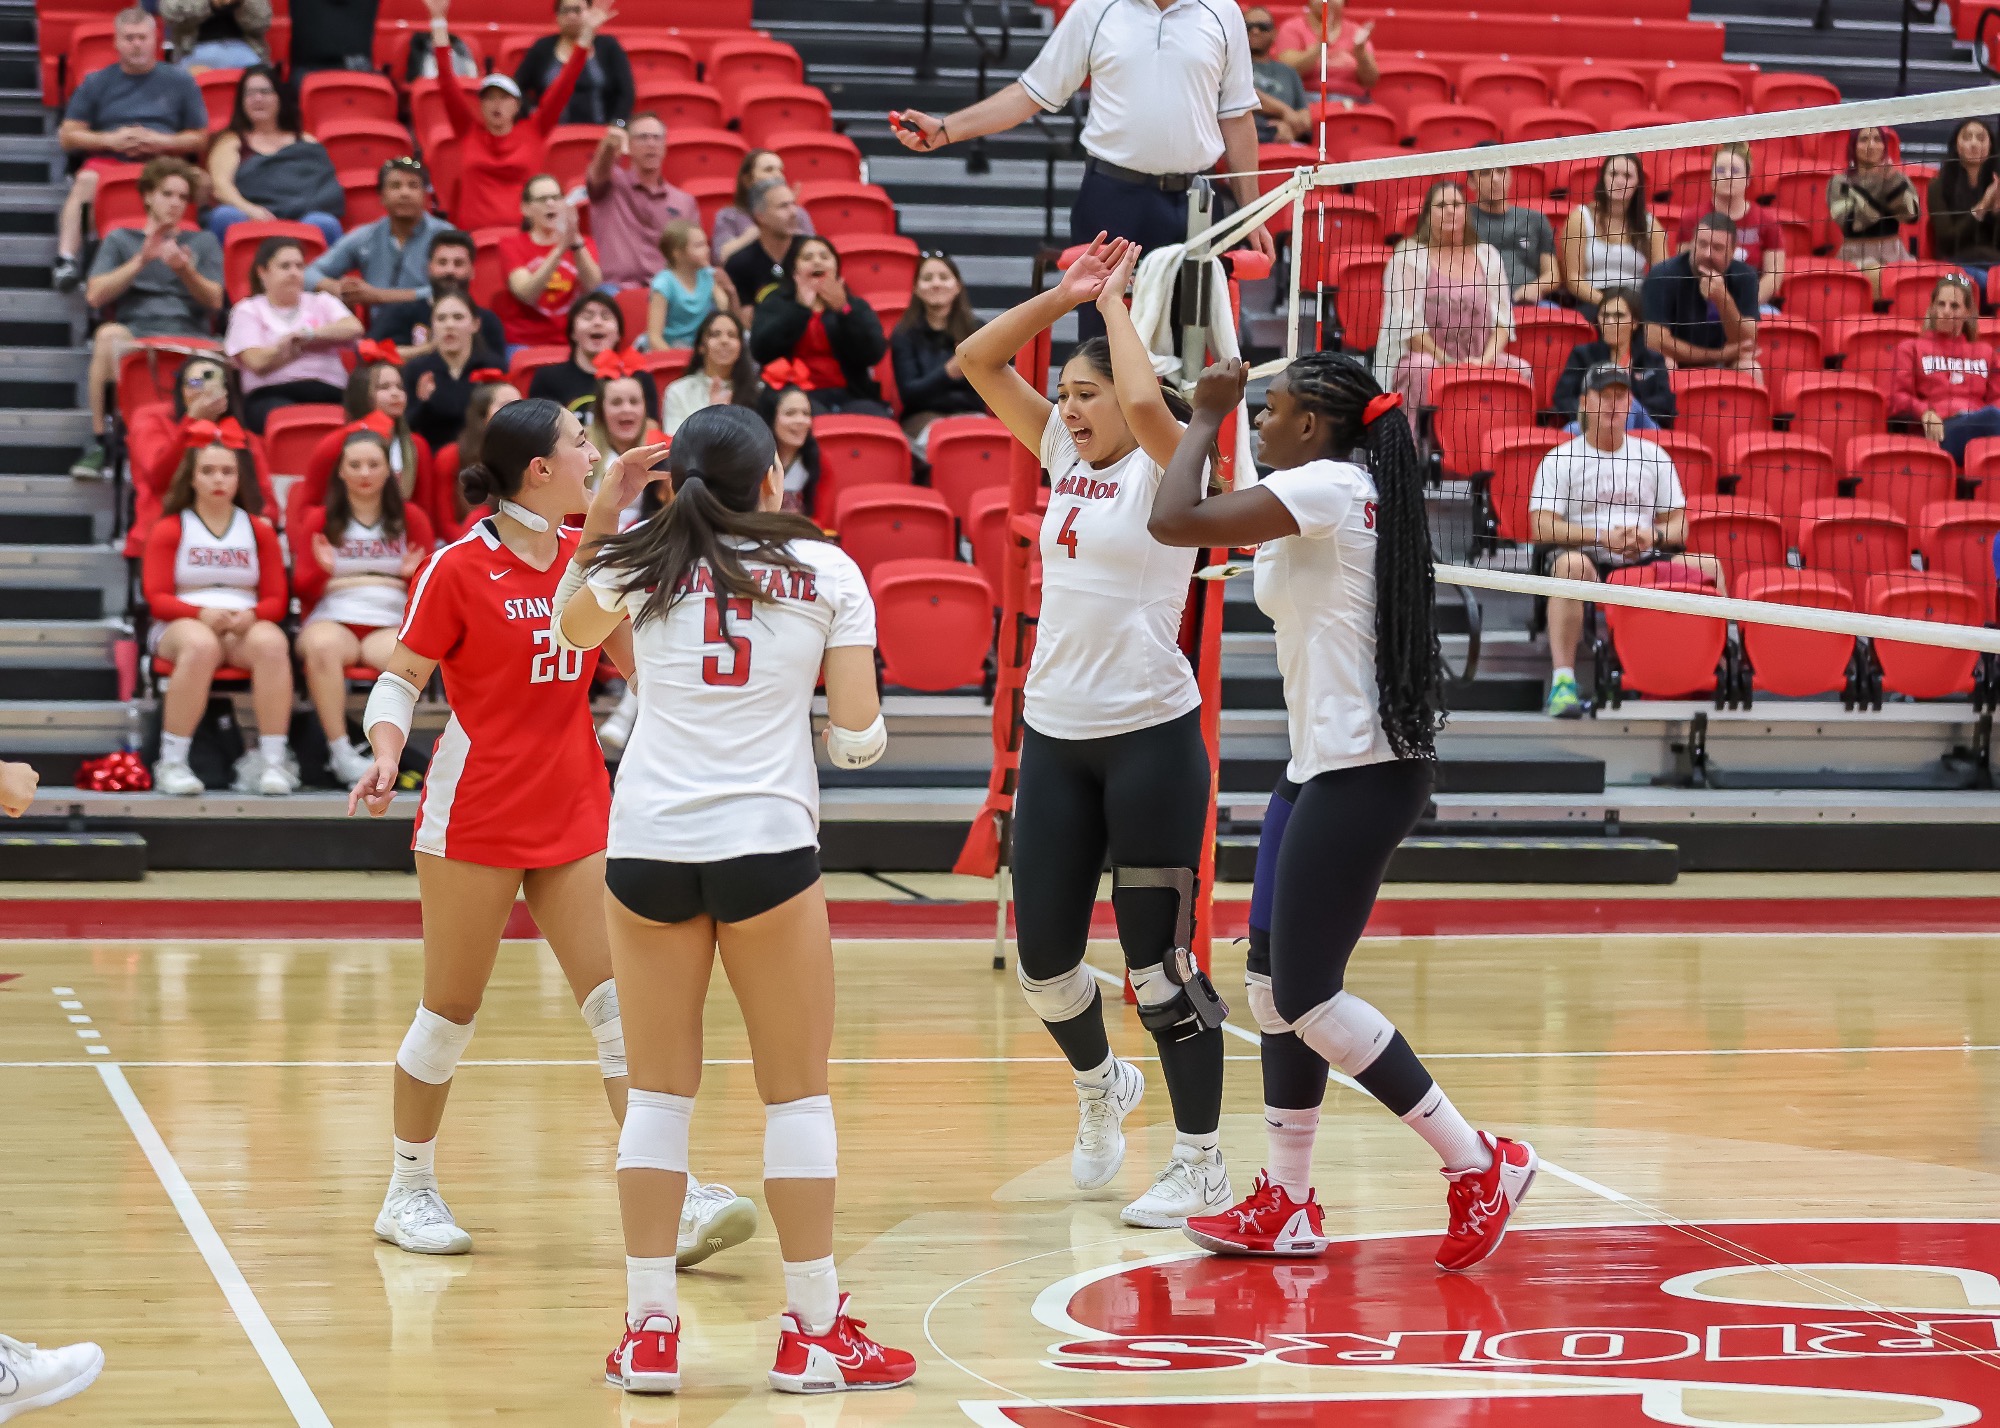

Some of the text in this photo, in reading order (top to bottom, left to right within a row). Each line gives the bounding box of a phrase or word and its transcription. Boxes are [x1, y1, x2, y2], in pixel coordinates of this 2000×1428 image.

[1056, 506, 1081, 559] 4
[188, 548, 250, 566] STAN
[745, 568, 818, 604] TATE
[504, 597, 552, 620] STAN
[529, 628, 584, 684] 20
[702, 597, 753, 686] 5
